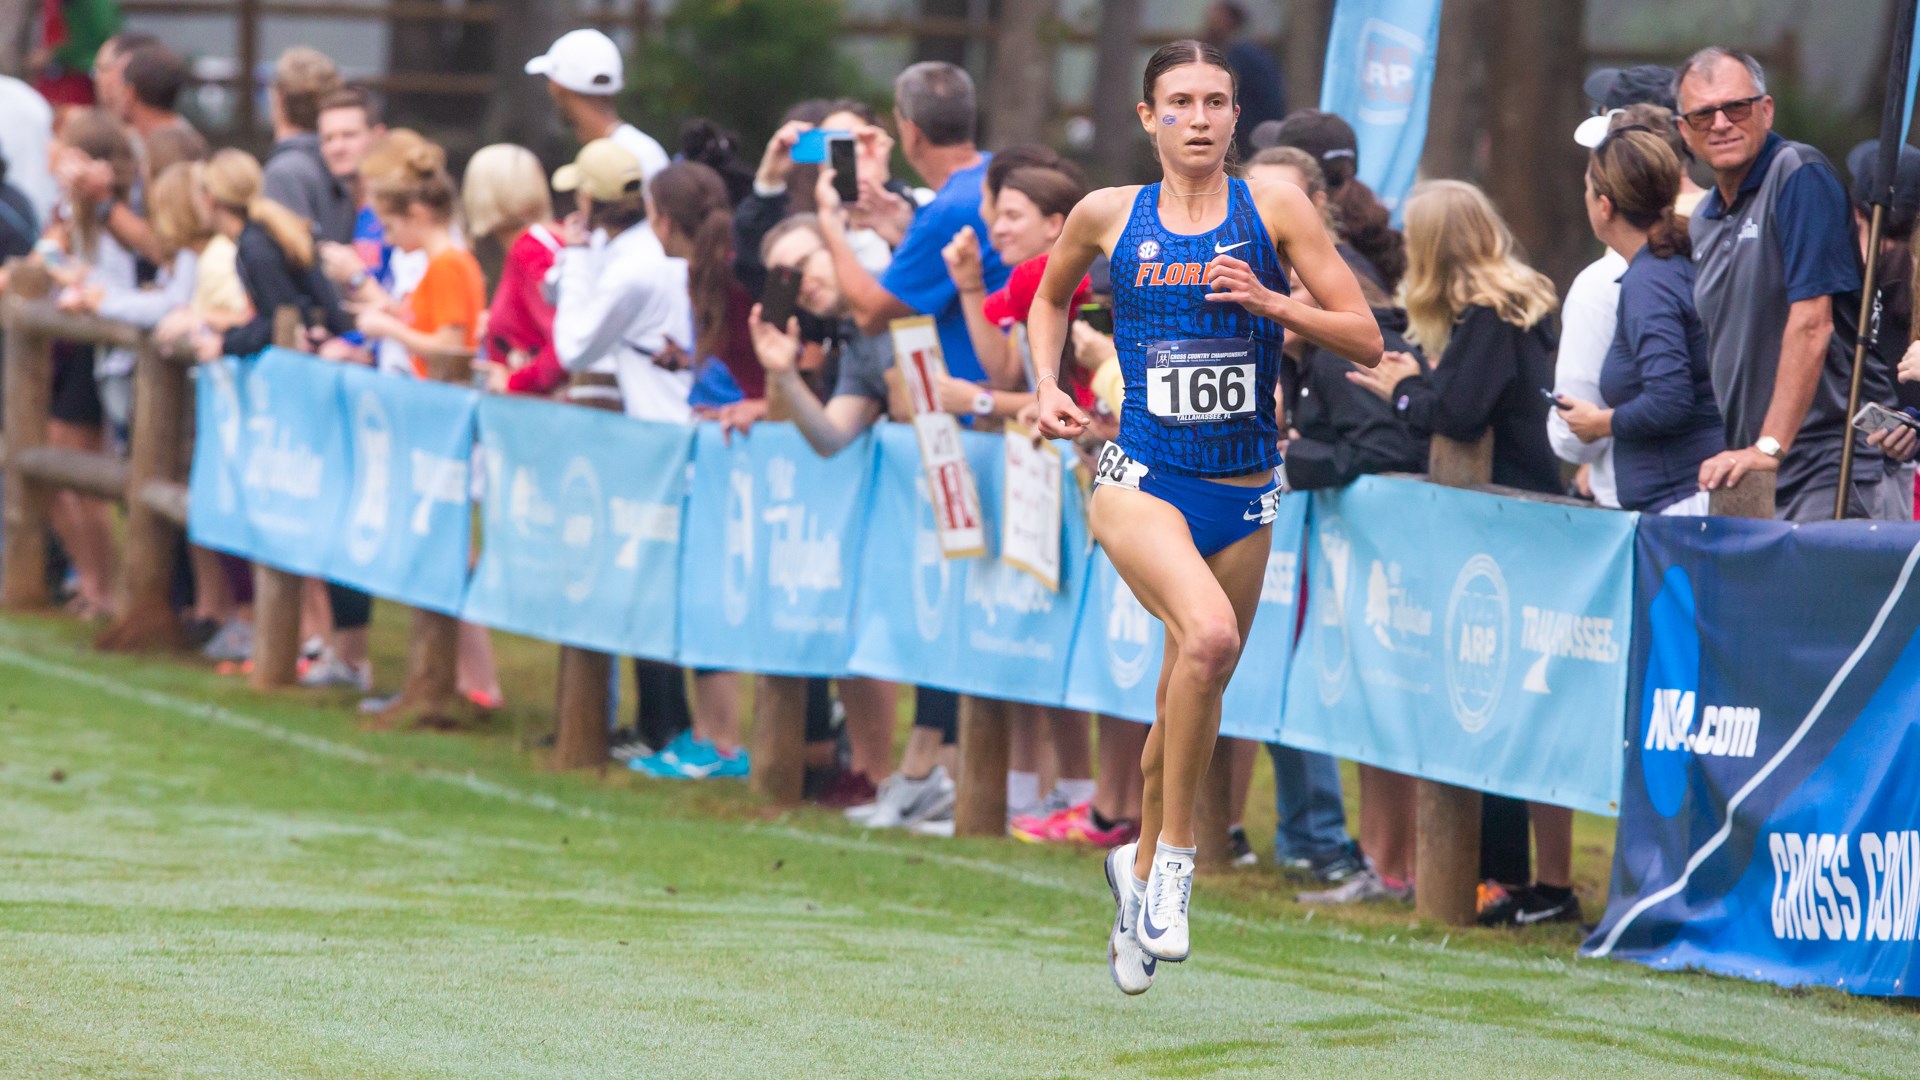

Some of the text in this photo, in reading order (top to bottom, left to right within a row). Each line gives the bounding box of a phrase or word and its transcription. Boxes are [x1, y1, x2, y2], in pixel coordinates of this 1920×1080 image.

[1139, 241, 1158, 259] SEC
[1134, 262, 1212, 287] FLORI
[1162, 367, 1245, 413] 166
[1098, 445, 1133, 483] 66
[1769, 829, 1920, 941] CROSS COUN
